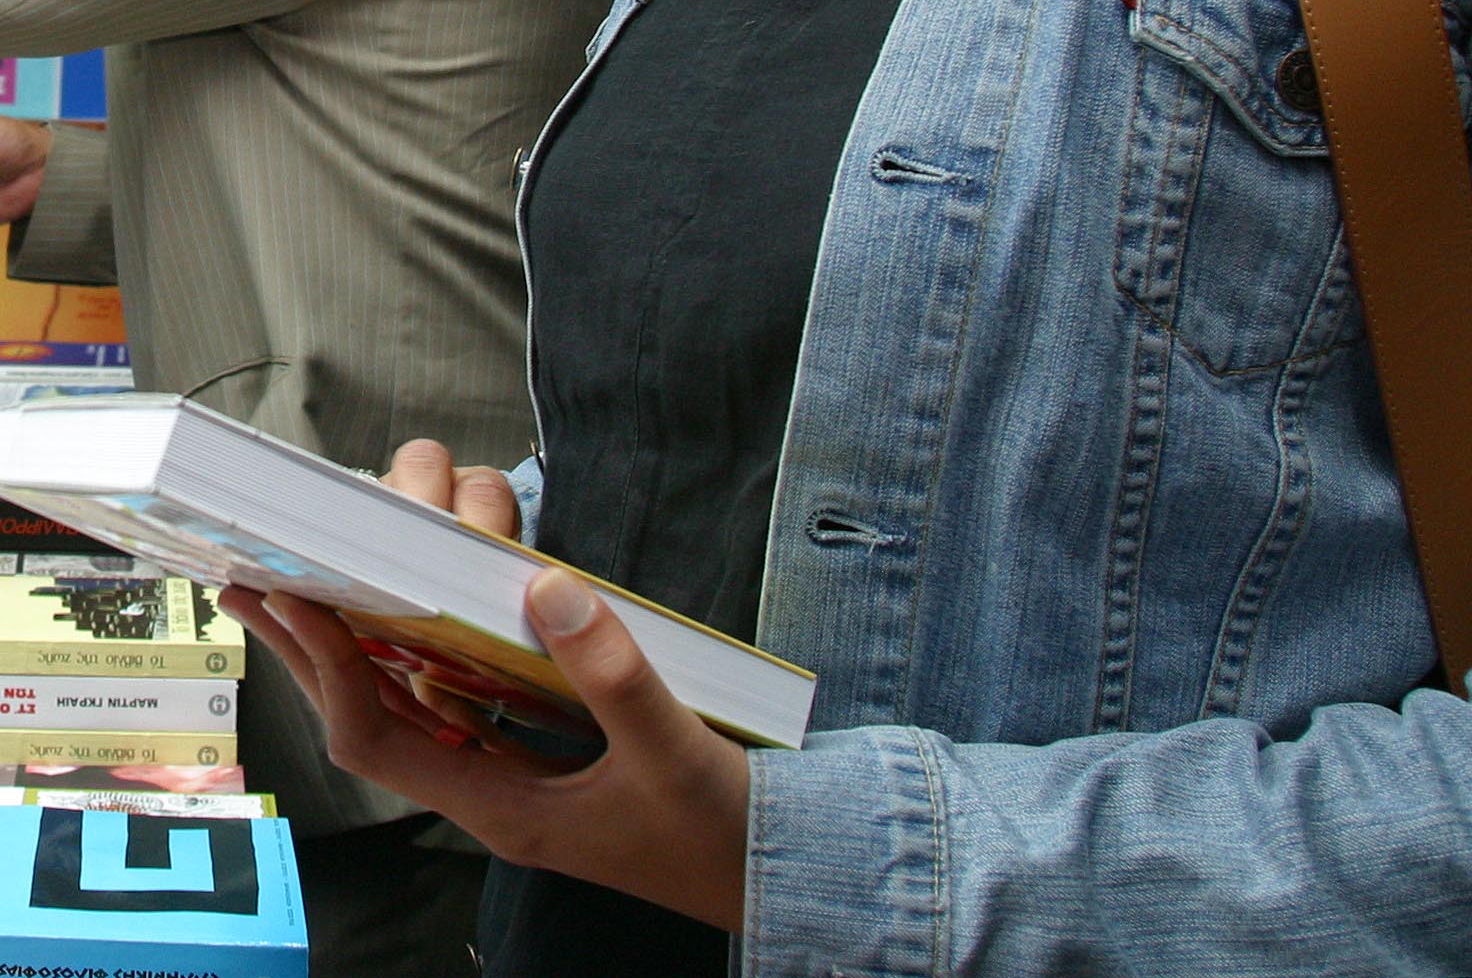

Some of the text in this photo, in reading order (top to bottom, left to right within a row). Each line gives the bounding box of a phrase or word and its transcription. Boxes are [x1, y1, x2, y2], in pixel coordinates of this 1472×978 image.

[3, 688, 36, 699] ΤΩΝ
[56, 696, 158, 710] ΜΑΡΤΙΝ ΓΚΡΑΙΗ
